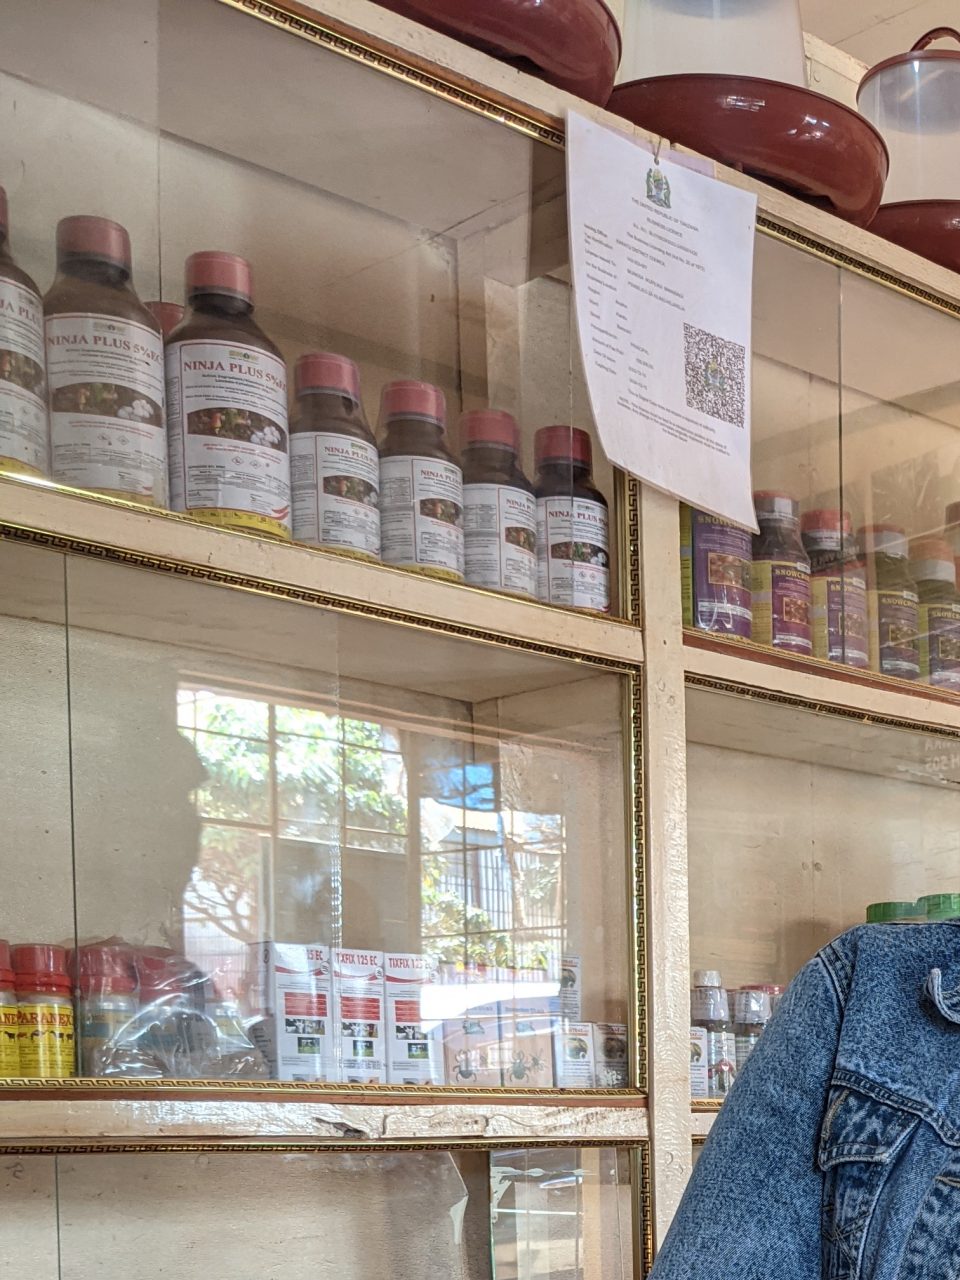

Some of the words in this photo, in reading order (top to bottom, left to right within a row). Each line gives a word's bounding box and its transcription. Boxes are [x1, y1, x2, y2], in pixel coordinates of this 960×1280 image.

[19, 306, 42, 327] PLU
[48, 335, 88, 346] NINJA
[92, 336, 130, 350] PLUS
[184, 360, 224, 372] NINJA
[230, 362, 263, 378] PLUS
[324, 446, 349, 456] NINJA
[420, 470, 443, 478] NINJA
[506, 498, 526, 508] NINJA
[577, 512, 597, 523] PLUS
[357, 954, 368, 965] 125
[370, 956, 377, 966] EC
[389, 958, 410, 968] TIXFIX
